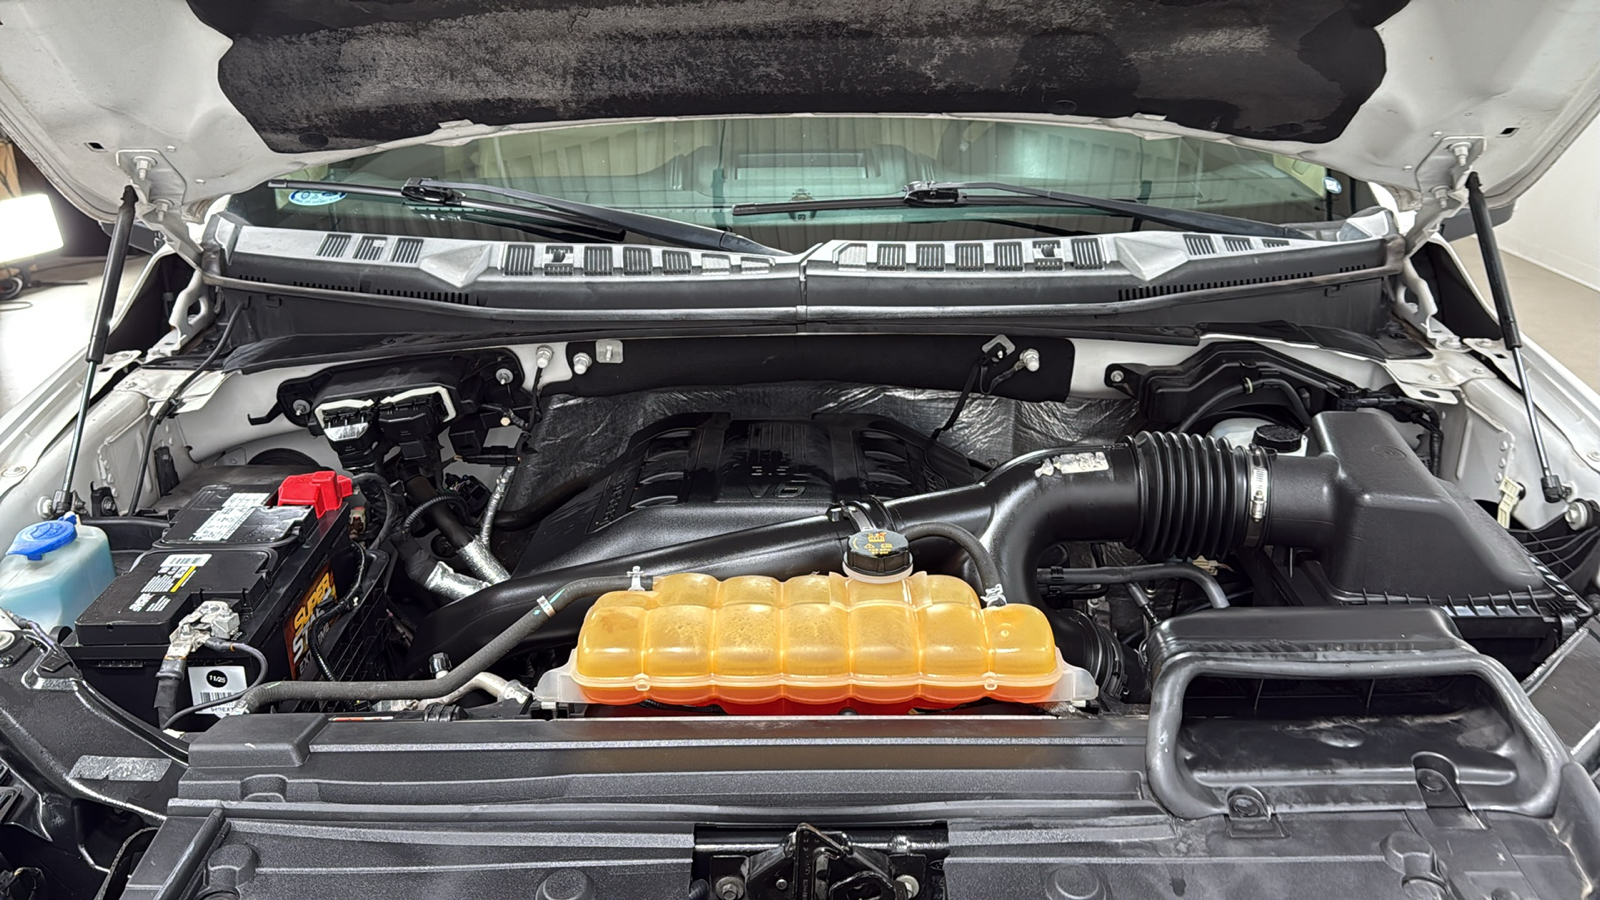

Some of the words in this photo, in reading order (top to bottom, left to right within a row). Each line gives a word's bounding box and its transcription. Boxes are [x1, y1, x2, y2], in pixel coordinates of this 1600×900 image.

[294, 572, 330, 638] SUPER
[299, 622, 331, 675] EXTEME
[209, 674, 226, 684] 11/25
